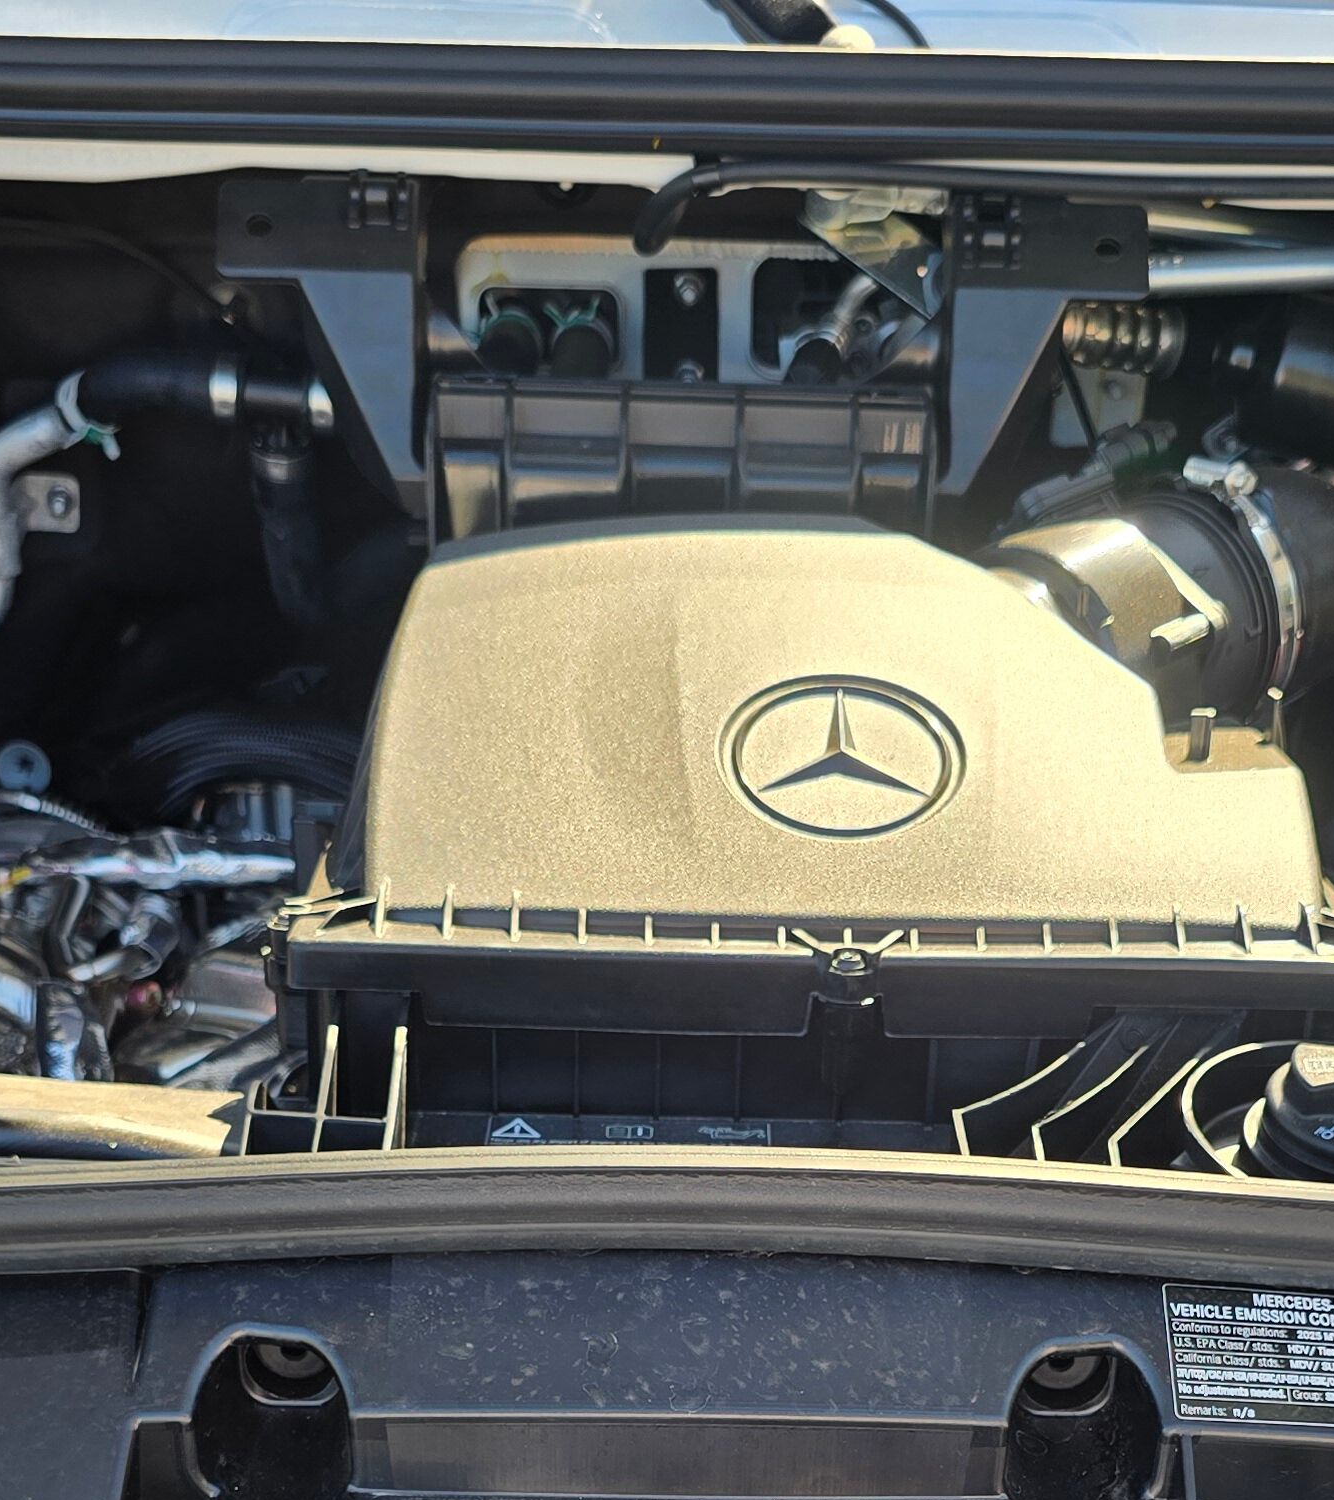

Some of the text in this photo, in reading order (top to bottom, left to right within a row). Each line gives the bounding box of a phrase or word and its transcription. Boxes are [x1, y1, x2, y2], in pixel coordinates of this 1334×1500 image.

[1169, 1302, 1234, 1320] VEHICLE
[1234, 1306, 1307, 1326] EMISSION
[1171, 1321, 1220, 1335] Conforms
[1220, 1325, 1232, 1335] to
[1232, 1325, 1289, 1339] regulations:
[1173, 1336, 1195, 1349] U.S.
[1196, 1338, 1217, 1350] EPA
[1217, 1339, 1251, 1352] Class/
[1175, 1352, 1223, 1365] California
[1222, 1355, 1255, 1368] Class/
[1177, 1383, 1192, 1395] No
[1193, 1384, 1249, 1398] adjustments
[1249, 1387, 1287, 1400] needed.
[1292, 1389, 1324, 1403] Group:
[1180, 1403, 1256, 1420] Remarks: n/a
